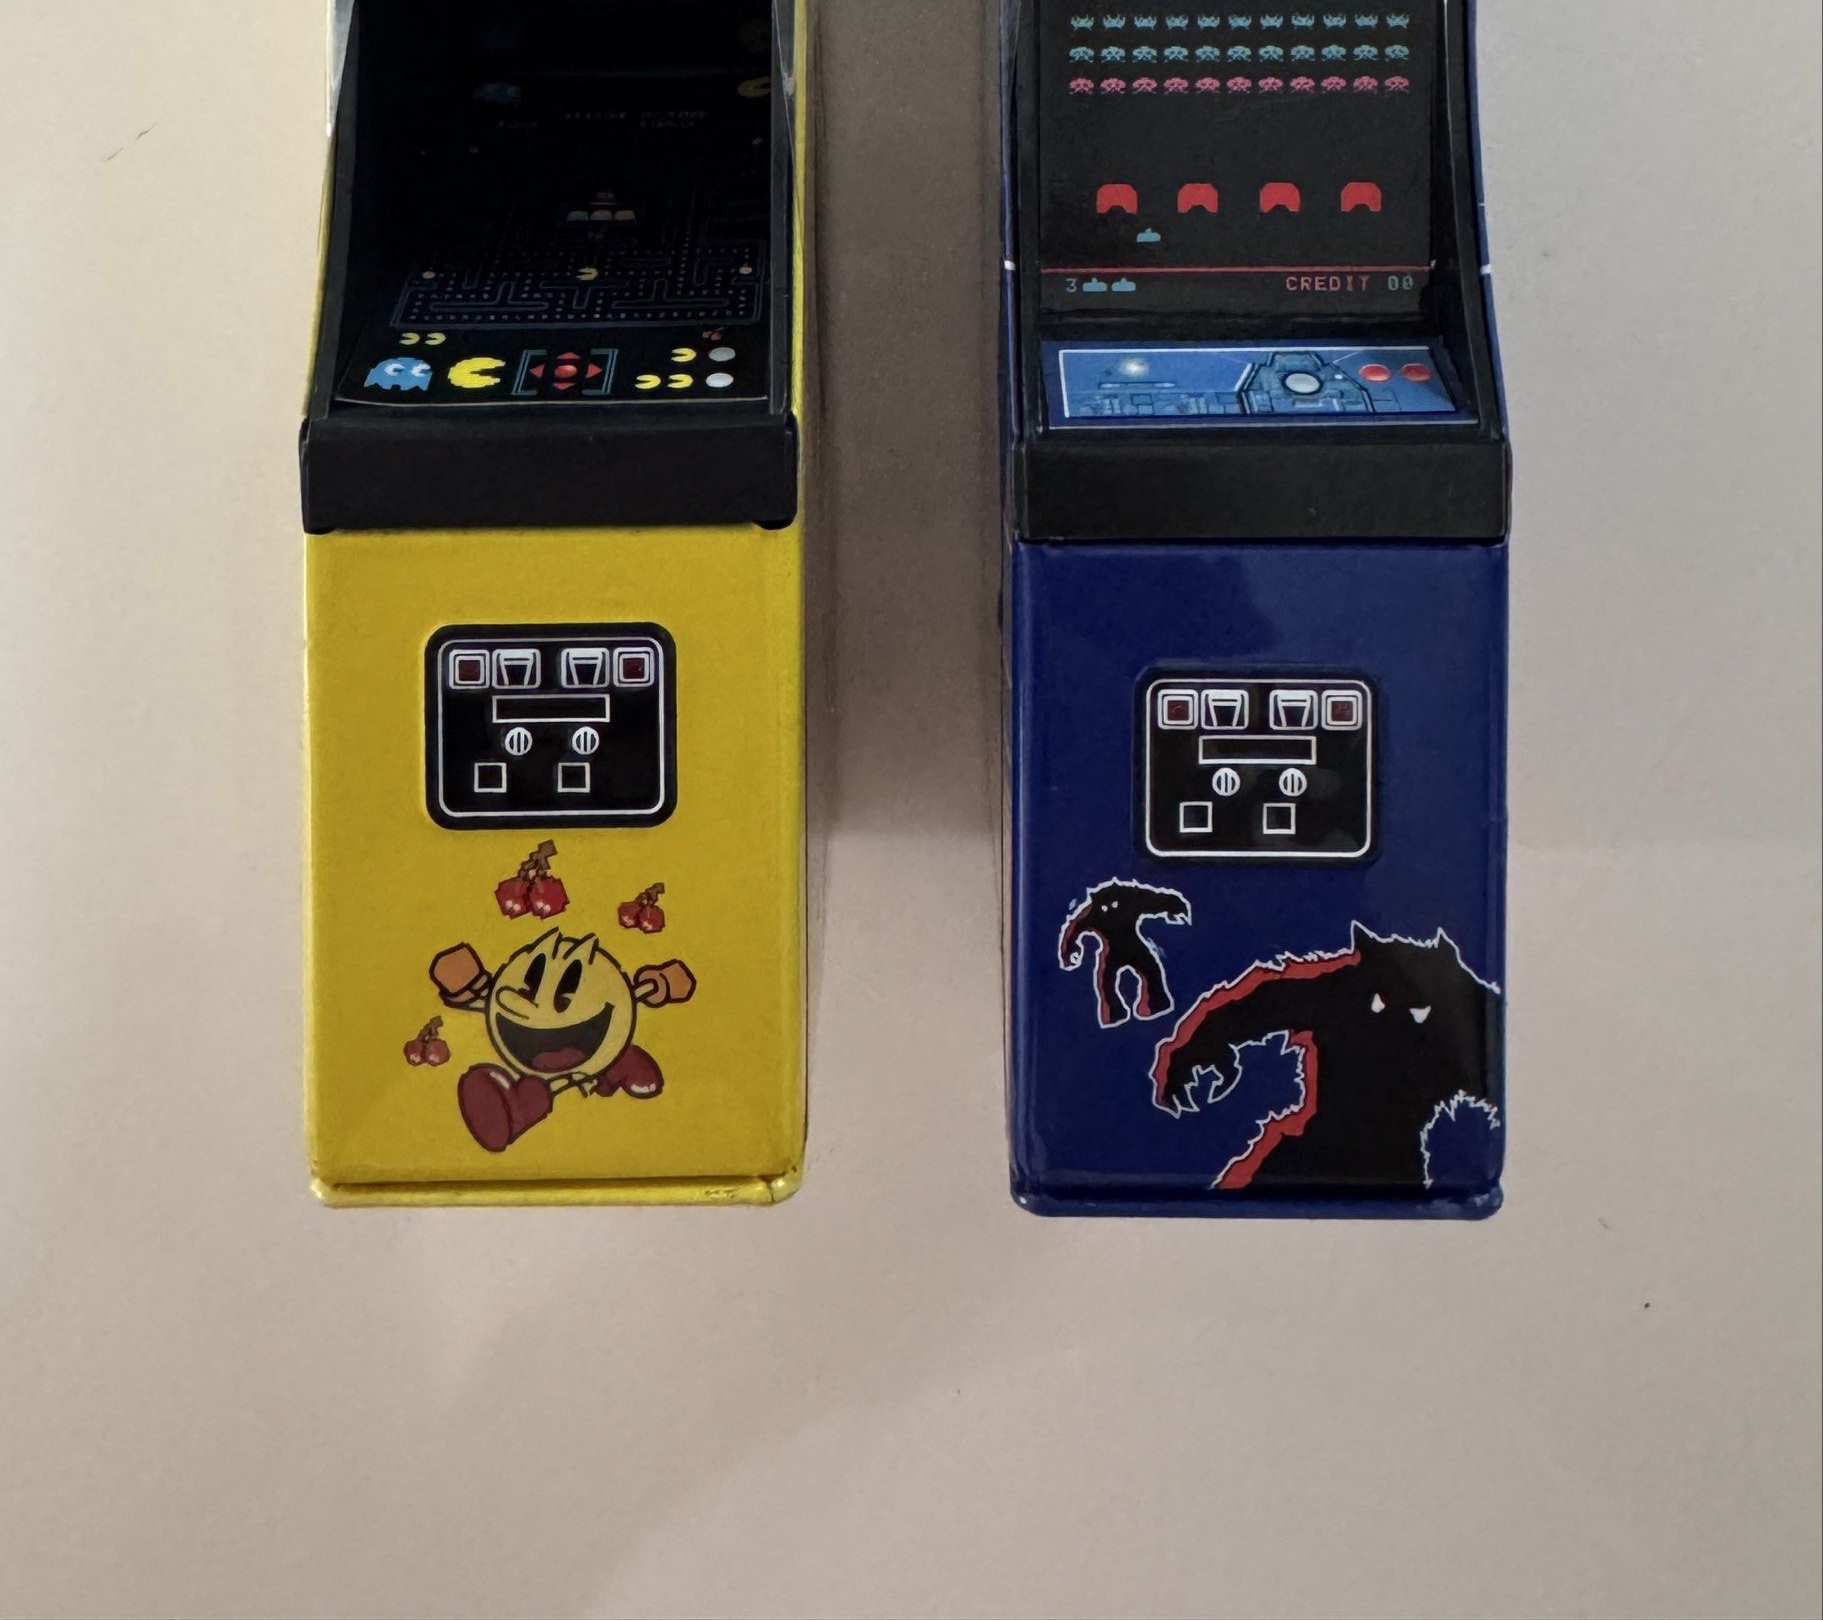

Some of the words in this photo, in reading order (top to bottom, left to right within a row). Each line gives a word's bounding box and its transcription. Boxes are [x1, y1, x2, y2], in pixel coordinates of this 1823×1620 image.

[1065, 277, 1078, 294] 3
[1285, 275, 1371, 293] CREDIT
[1387, 274, 1414, 292] 00
